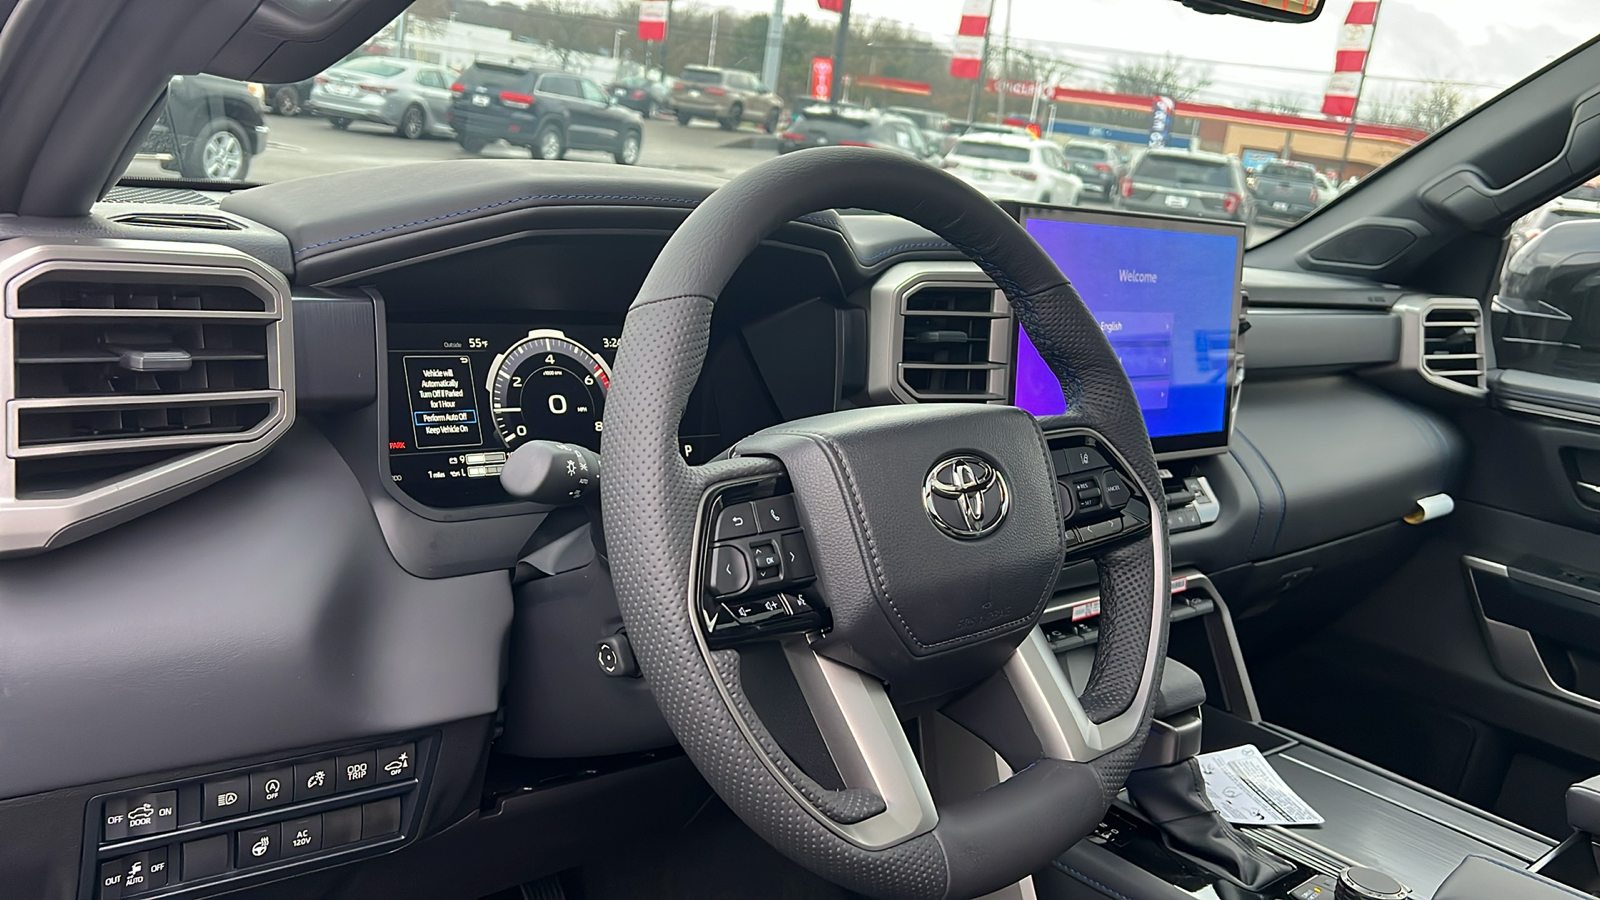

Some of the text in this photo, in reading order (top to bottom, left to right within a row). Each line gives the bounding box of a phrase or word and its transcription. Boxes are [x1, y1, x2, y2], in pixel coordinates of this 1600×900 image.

[1118, 269, 1158, 283] Welcome
[1100, 321, 1123, 333] English
[545, 354, 555, 365] 4
[422, 368, 454, 377] Vehicle will
[421, 379, 459, 389] Automatically
[512, 376, 523, 388] 2
[584, 375, 594, 386] 6
[419, 390, 432, 399] Turn
[432, 389, 440, 398] Off
[445, 388, 464, 398] Parked
[430, 400, 439, 408] for
[442, 400, 456, 408] Hour
[548, 394, 567, 414] 0
[423, 412, 468, 422] Perform Auto Off
[425, 426, 440, 435] Keep
[440, 425, 460, 433] Vehicle
[516, 425, 527, 436] 0
[594, 421, 603, 432] 8
[389, 442, 406, 450] PARK
[684, 444, 693, 457] P
[347, 762, 368, 774] ODO
[347, 769, 367, 781] TRIP
[266, 792, 279, 800] OFF
[158, 807, 172, 817] ON
[107, 815, 124, 825] OFF
[129, 817, 151, 828] DOOR
[296, 829, 309, 839] AC
[292, 836, 312, 848] 120V
[150, 862, 165, 873] OFF
[105, 875, 121, 886] OUT
[125, 876, 144, 887] AUTO
